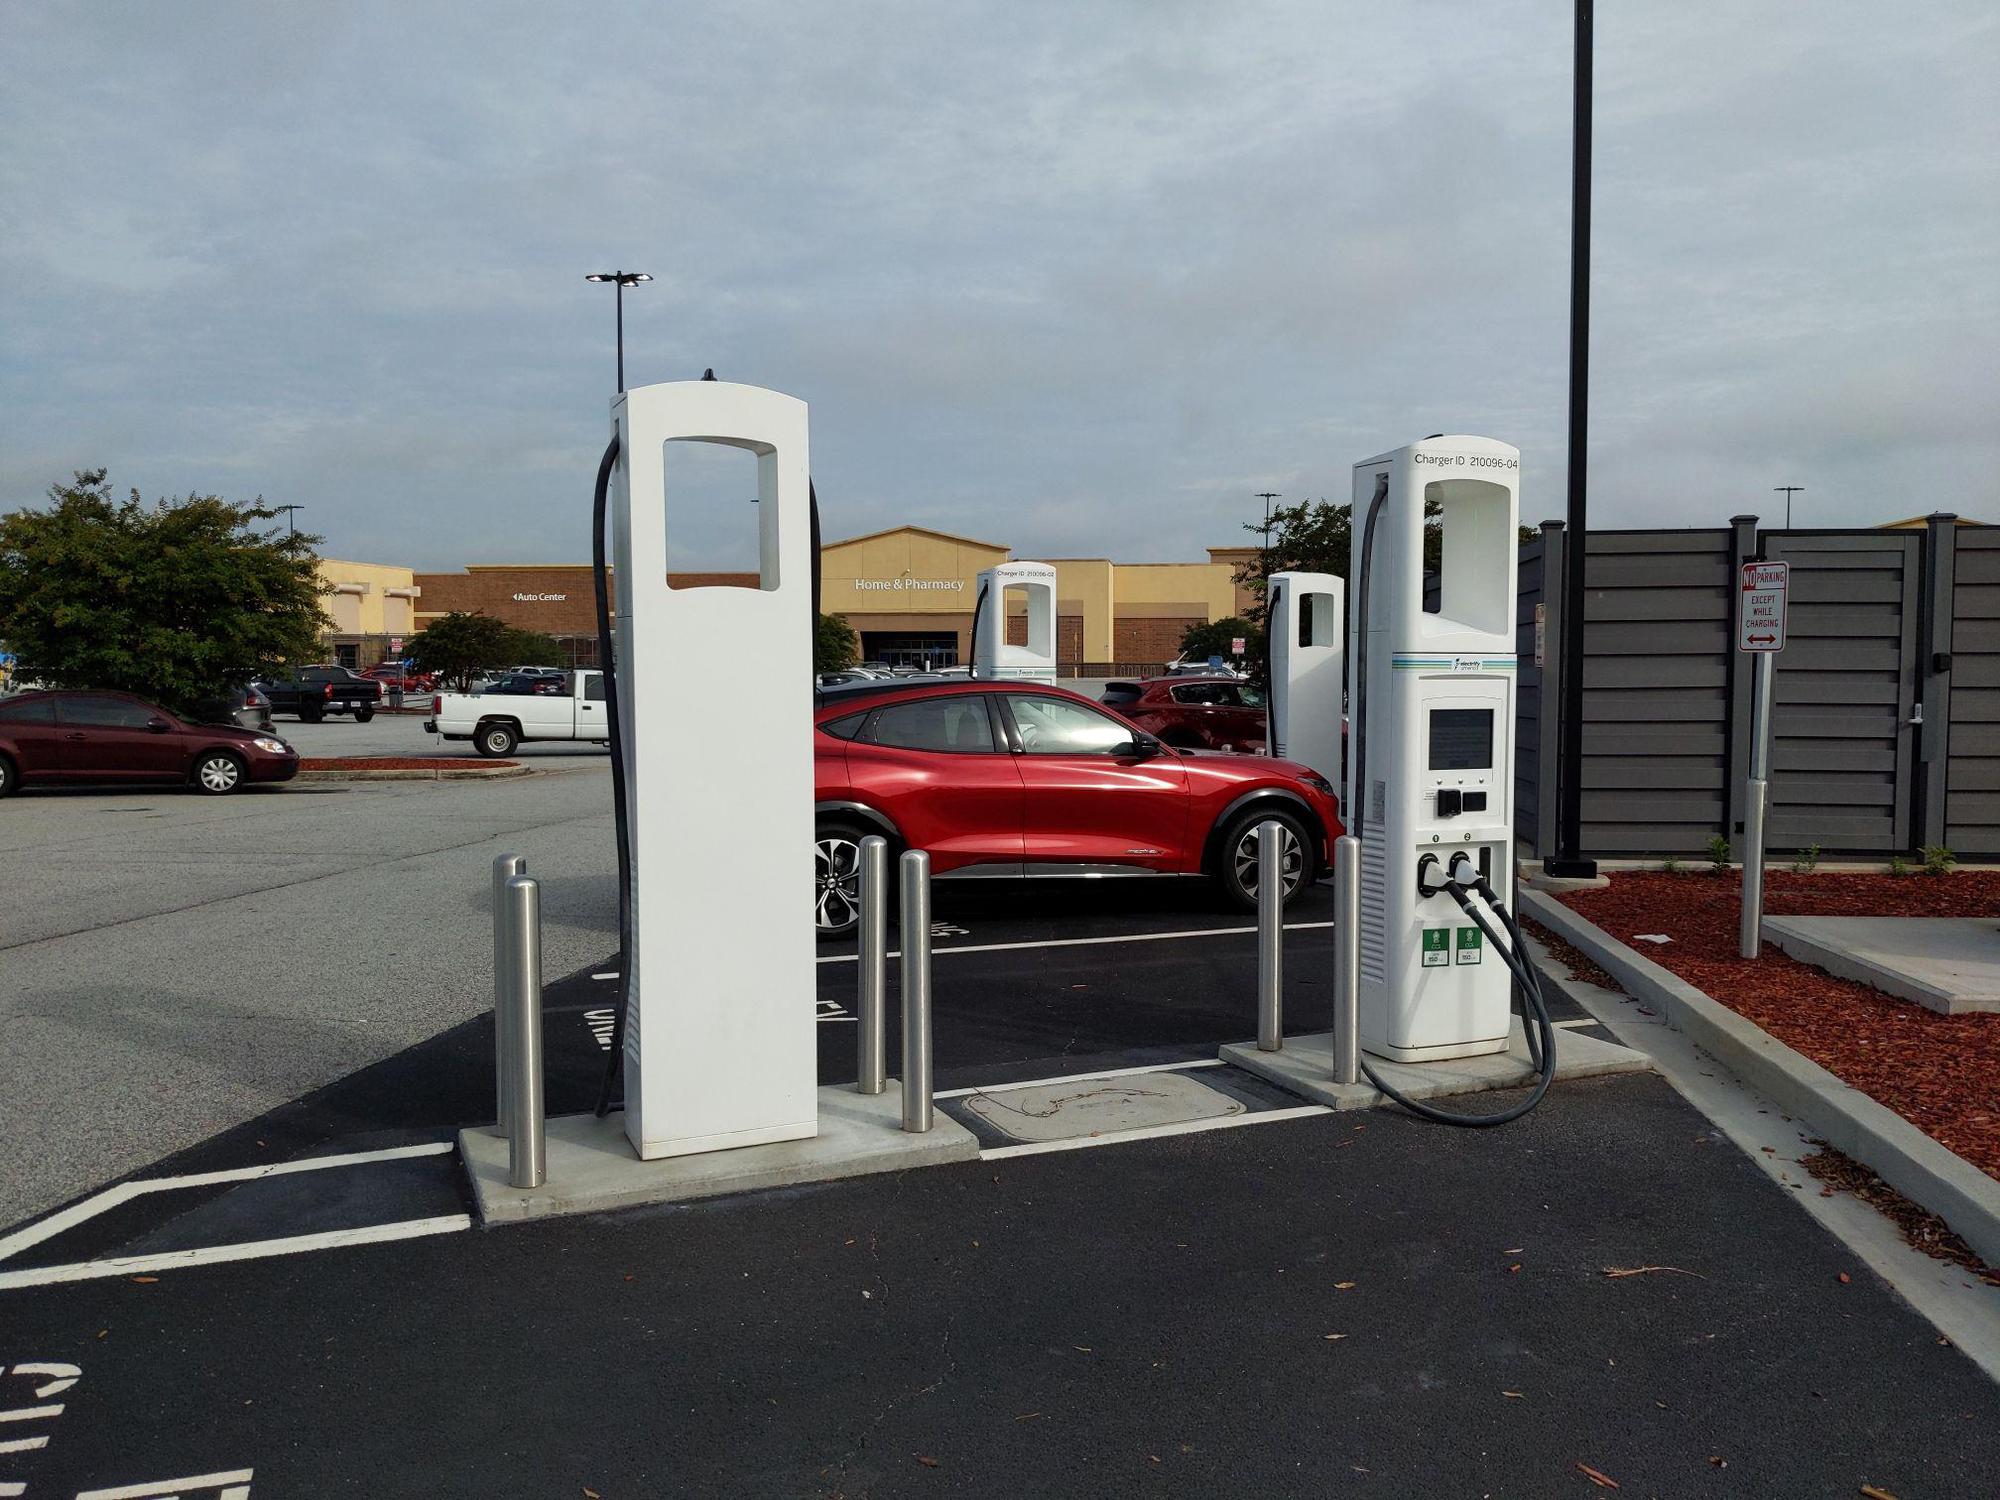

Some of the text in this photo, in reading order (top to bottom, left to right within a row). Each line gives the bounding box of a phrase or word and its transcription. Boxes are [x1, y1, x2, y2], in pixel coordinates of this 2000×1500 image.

[1415, 453, 1518, 469] Charger ID 210096-04
[1743, 570, 1785, 586] NO PARKING
[855, 579, 964, 592] Home & Pharmacy
[517, 592, 567, 601] Auto Center
[1751, 595, 1776, 604] EXCEPT
[1753, 607, 1773, 616] WHILE
[1745, 619, 1779, 628] CHARGING
